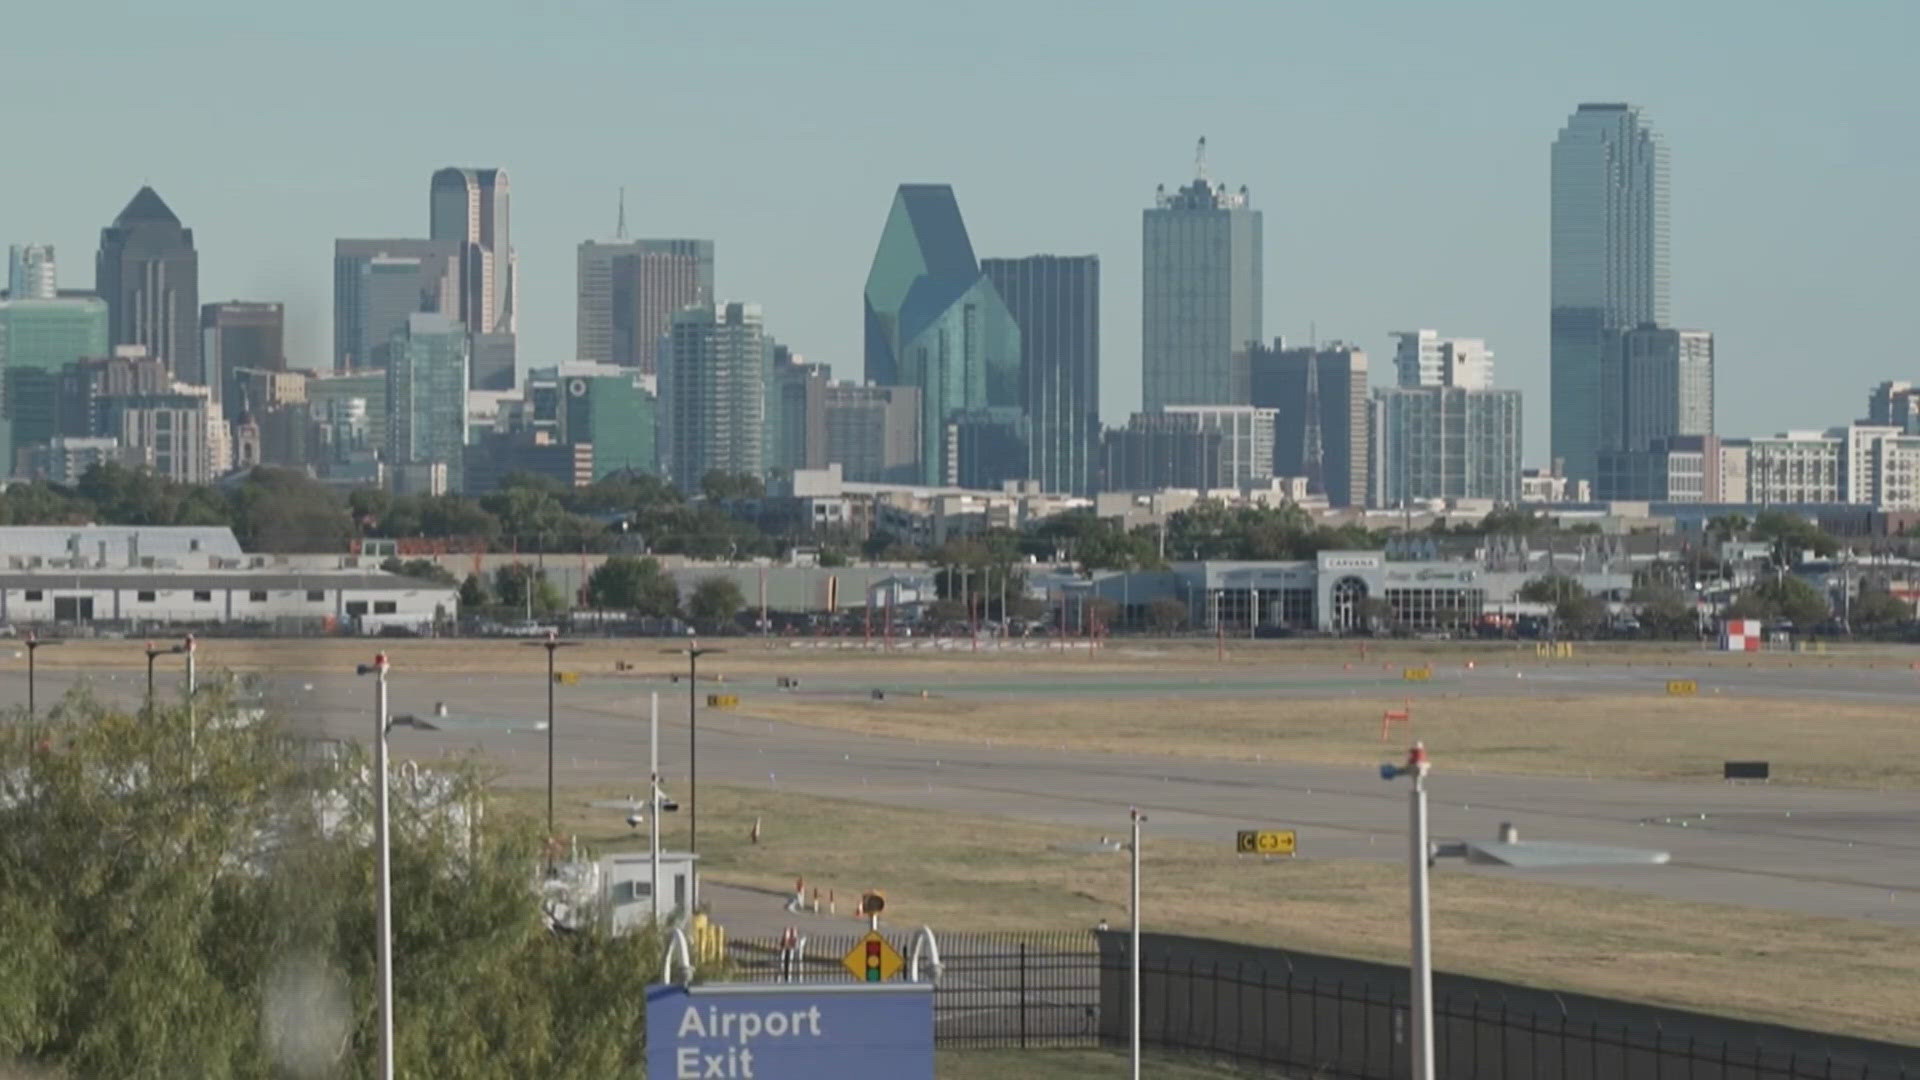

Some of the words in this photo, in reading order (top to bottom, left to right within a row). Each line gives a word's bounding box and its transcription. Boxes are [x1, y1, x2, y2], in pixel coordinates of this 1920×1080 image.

[1328, 558, 1375, 568] CARVANA
[677, 1005, 821, 1044] Airport
[676, 1047, 754, 1079] Exit
